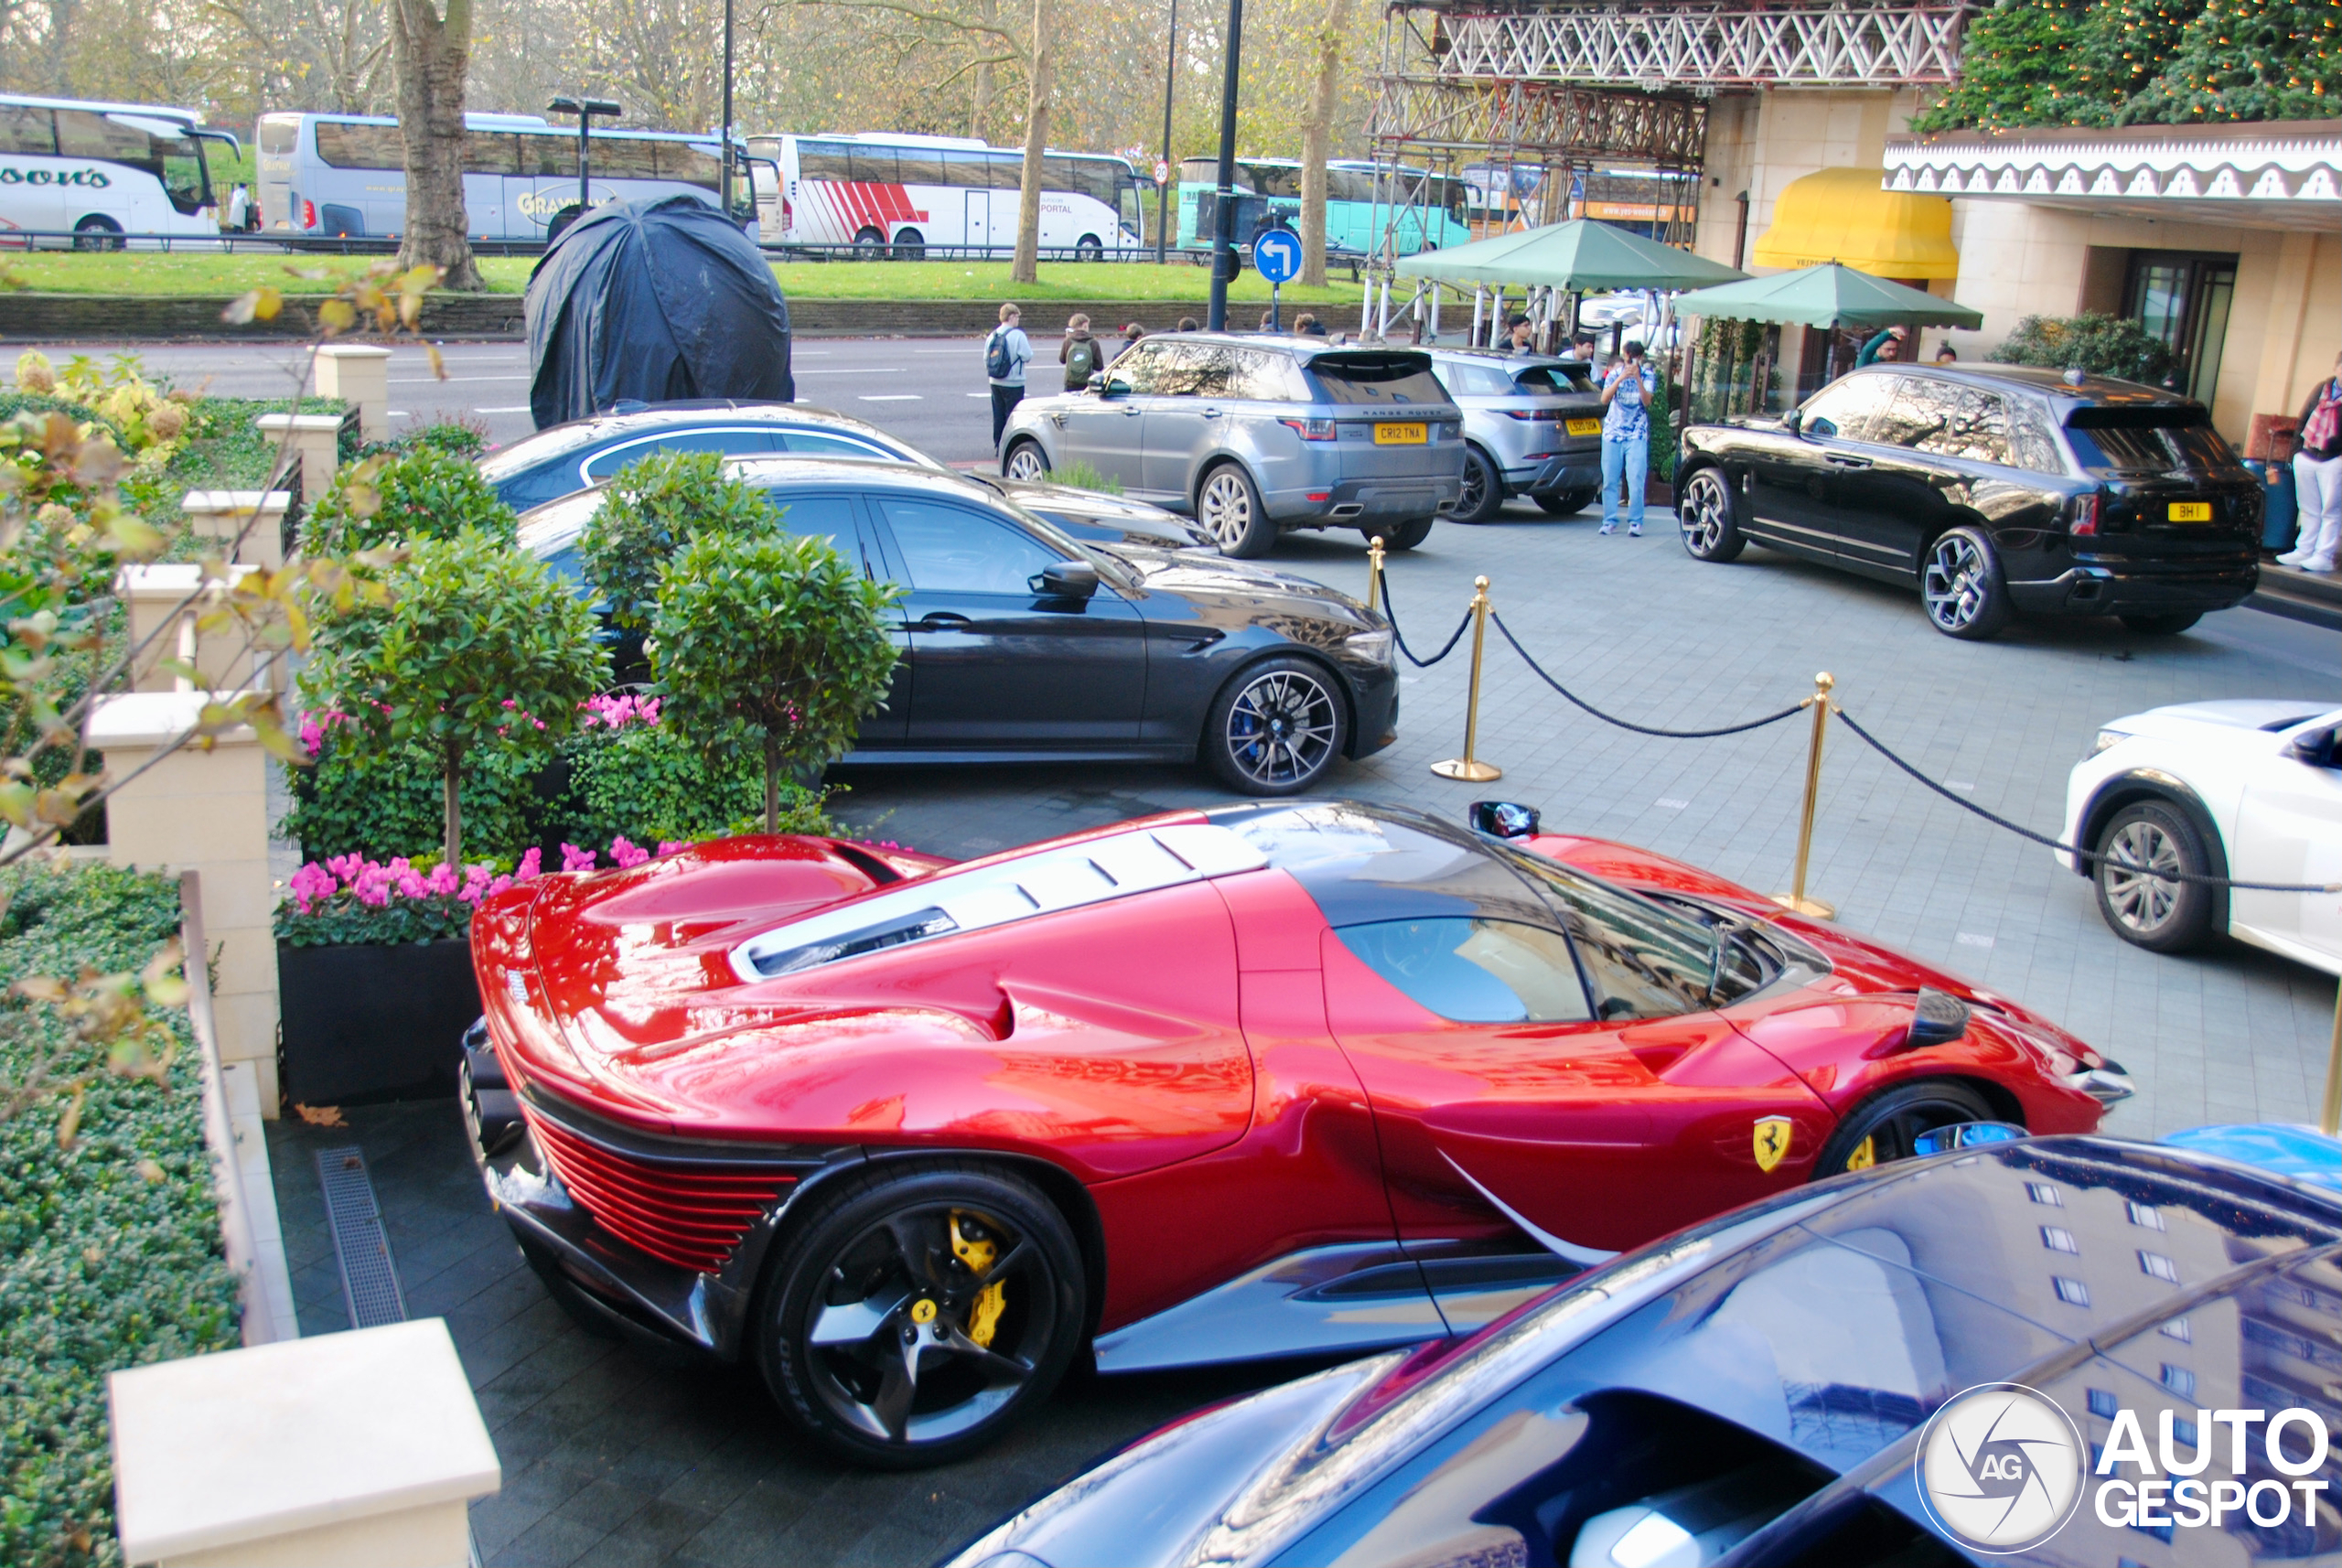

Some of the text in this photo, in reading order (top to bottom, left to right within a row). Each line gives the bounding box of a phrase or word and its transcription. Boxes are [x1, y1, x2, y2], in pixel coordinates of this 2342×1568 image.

[1156, 167, 1166, 177] 20
[1040, 204, 1072, 214] PORTAL
[1380, 427, 1420, 439] CR12 TNA
[2179, 505, 2194, 518] BH
